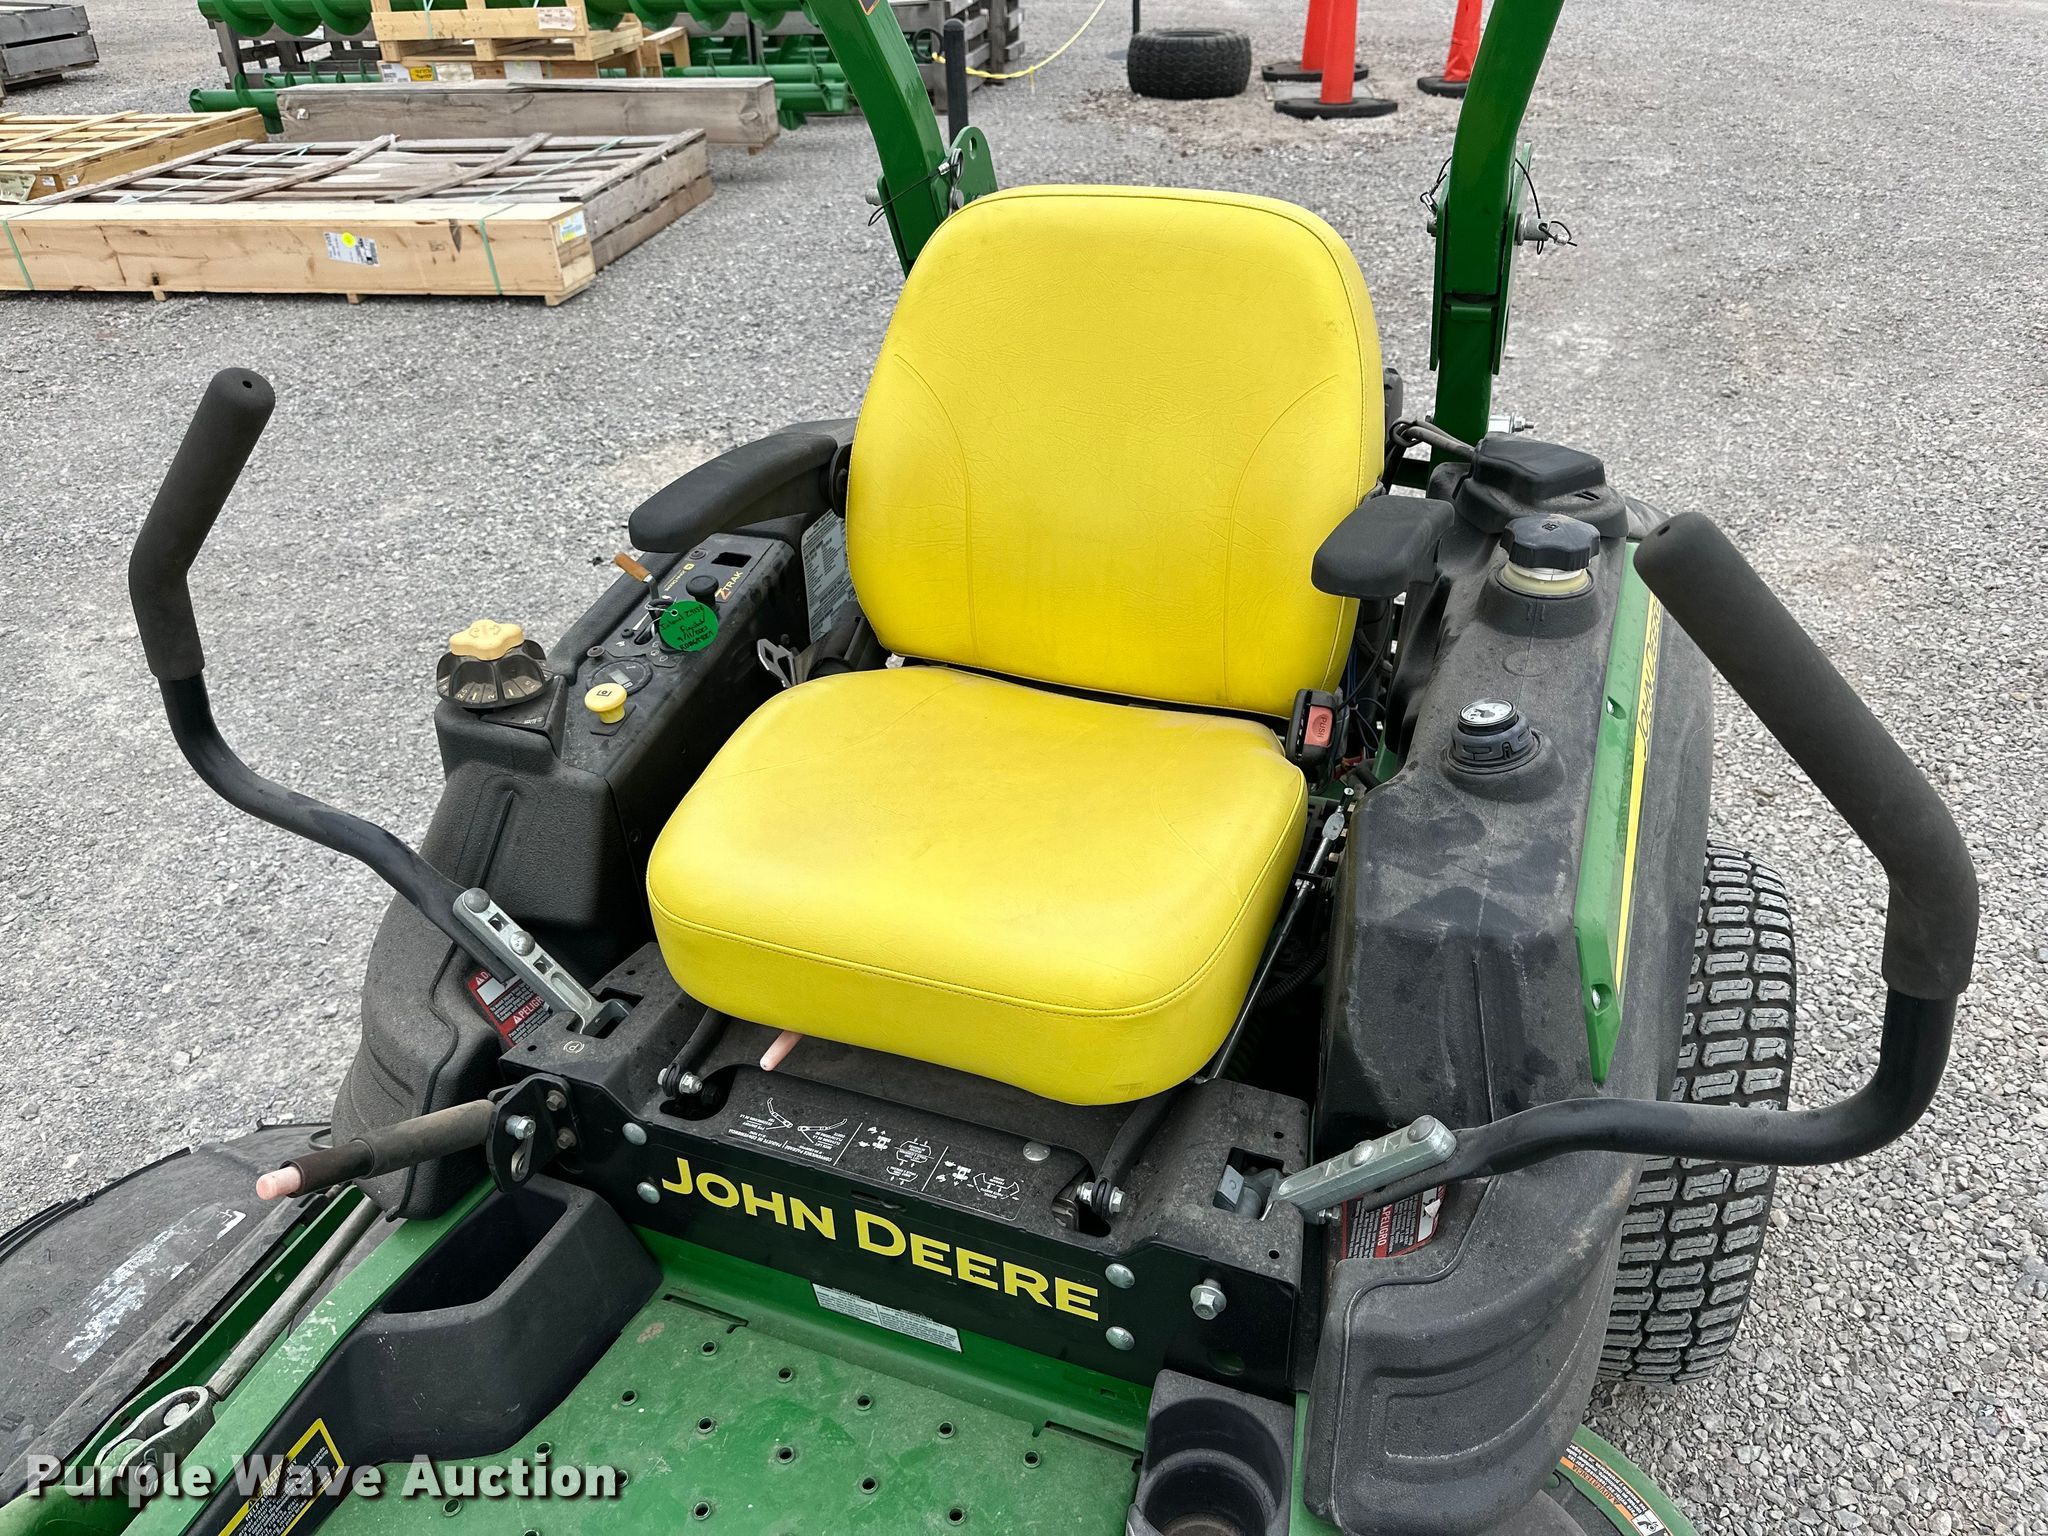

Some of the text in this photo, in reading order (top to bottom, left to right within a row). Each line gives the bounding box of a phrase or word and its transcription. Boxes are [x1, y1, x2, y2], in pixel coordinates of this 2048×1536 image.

[1318, 714, 1328, 738] PUSH
[518, 996, 544, 1018] PELIGR
[661, 1157, 836, 1240] JOHN
[855, 1209, 1099, 1321] DEERE
[1377, 1209, 1391, 1246] PELIGRO
[1571, 1464, 1613, 1500] ADVERTENCIA
[245, 1502, 261, 1521] HELP
